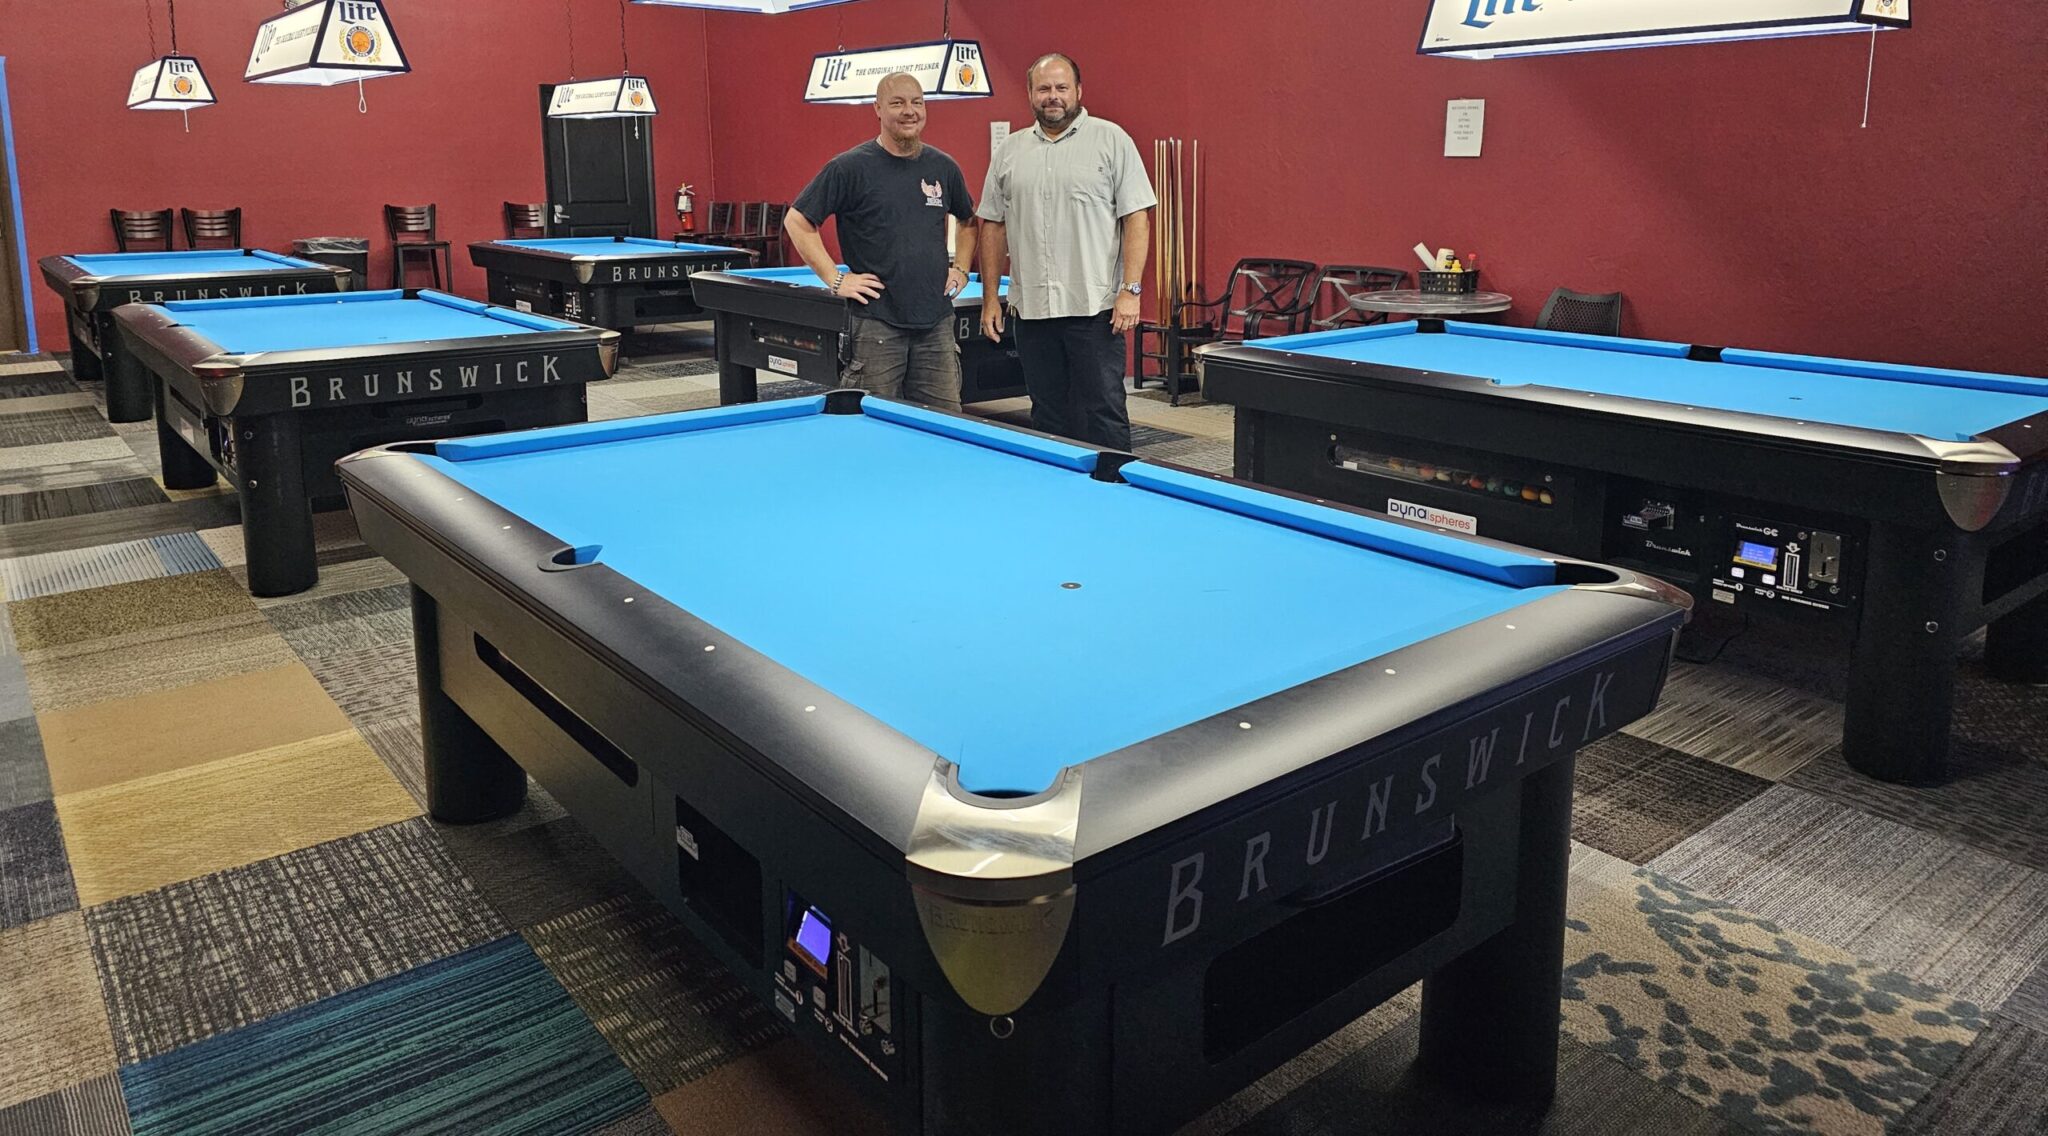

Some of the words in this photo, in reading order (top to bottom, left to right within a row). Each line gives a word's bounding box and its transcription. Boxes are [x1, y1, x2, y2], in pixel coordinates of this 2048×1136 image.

[339, 1, 377, 24] Lite
[955, 46, 977, 63] Lite
[168, 61, 194, 75] Lite
[820, 58, 851, 89] Lite
[628, 79, 645, 90] Lite
[129, 281, 317, 304] BRUNSWICK
[290, 355, 561, 407] BRUNSWICK
[1429, 513, 1471, 530] spheres
[1161, 672, 1615, 948] BRUNSWICK
